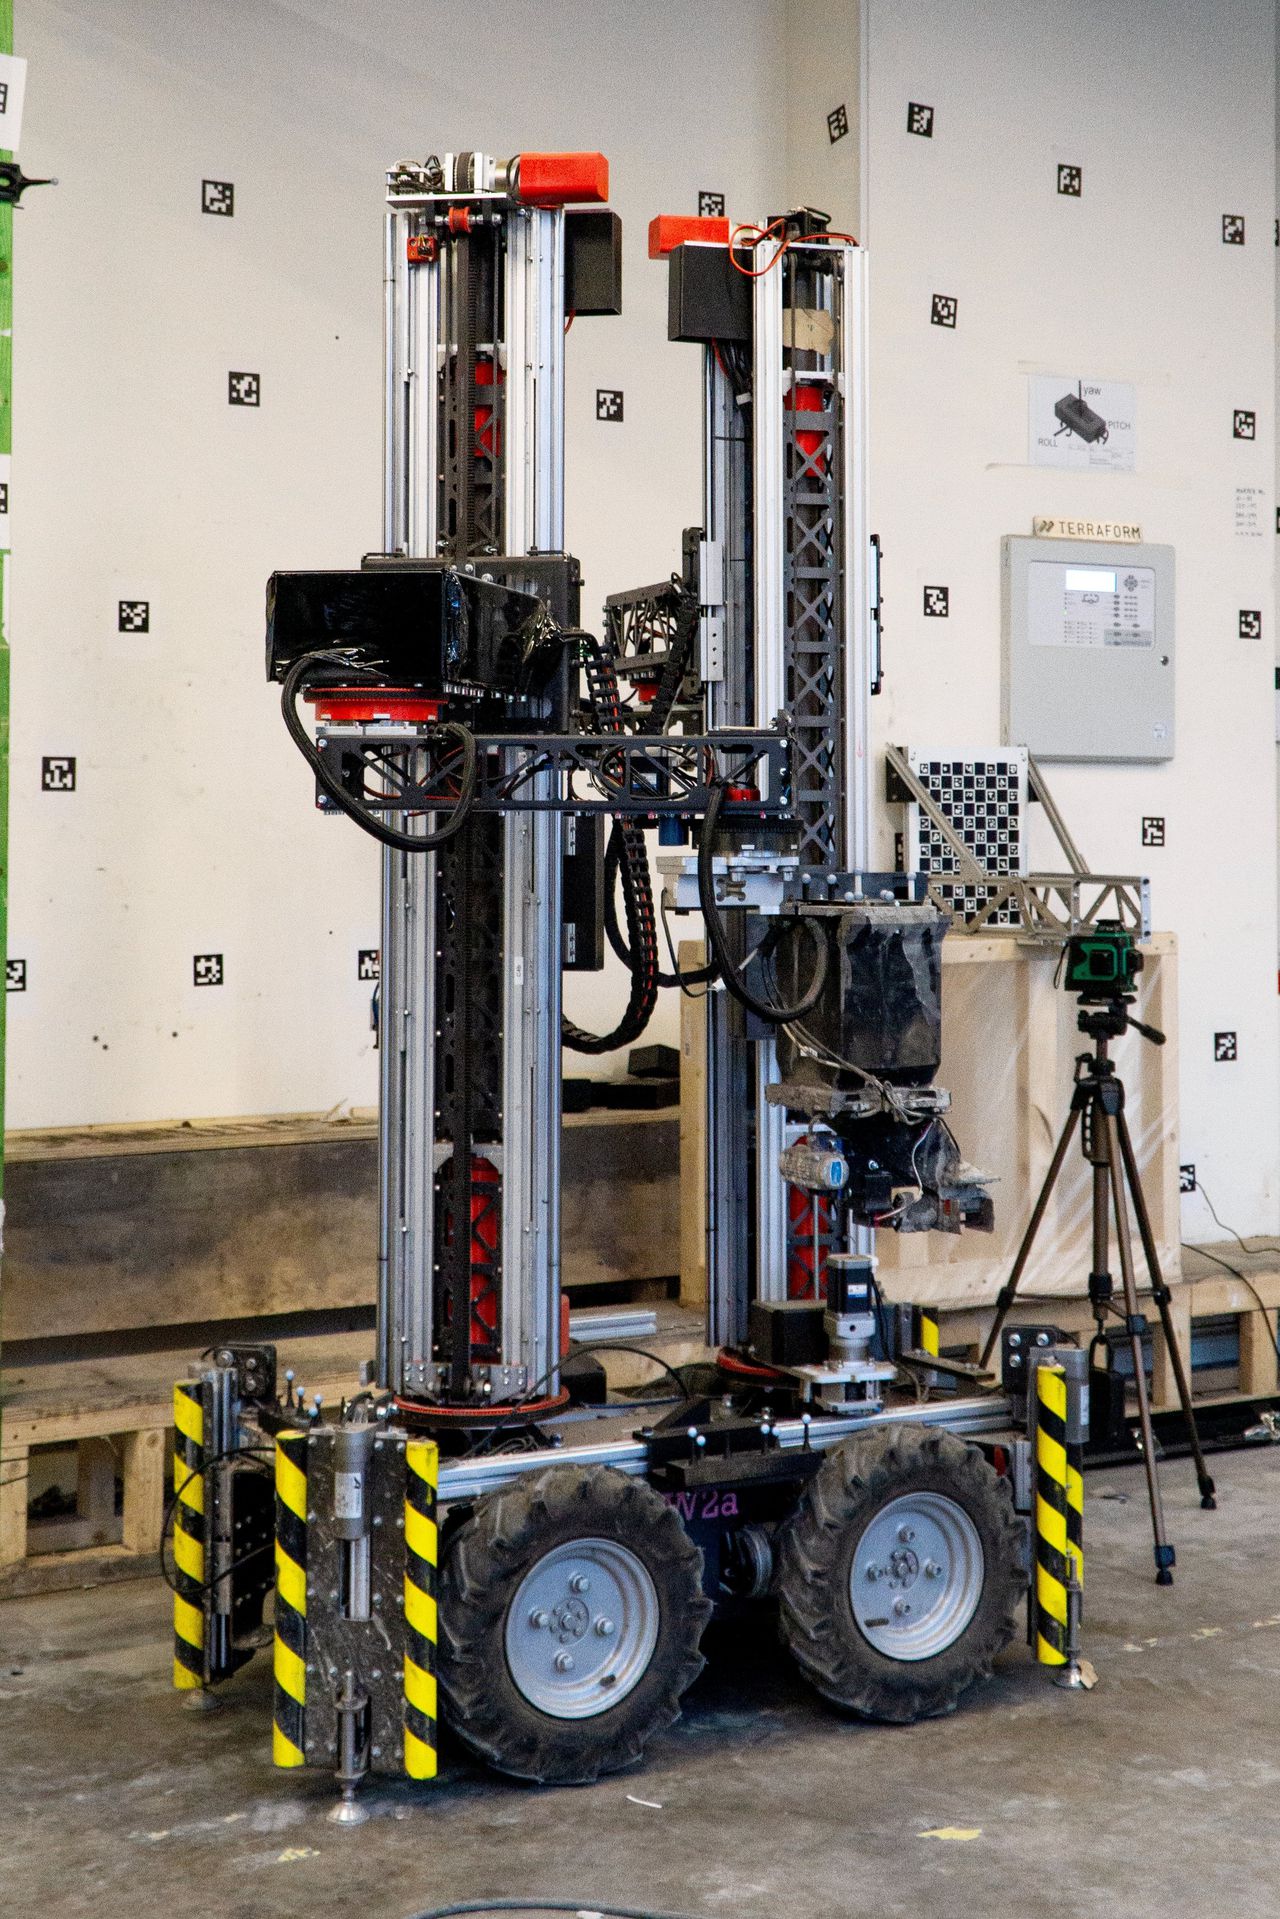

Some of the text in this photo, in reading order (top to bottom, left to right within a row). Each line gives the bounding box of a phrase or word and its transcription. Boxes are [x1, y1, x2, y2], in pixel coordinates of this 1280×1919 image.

[1083, 386, 1102, 397] yaw
[1108, 420, 1131, 431] PITCH
[1038, 437, 1058, 448] ROLL
[1058, 520, 1141, 540] TERRAFORM
